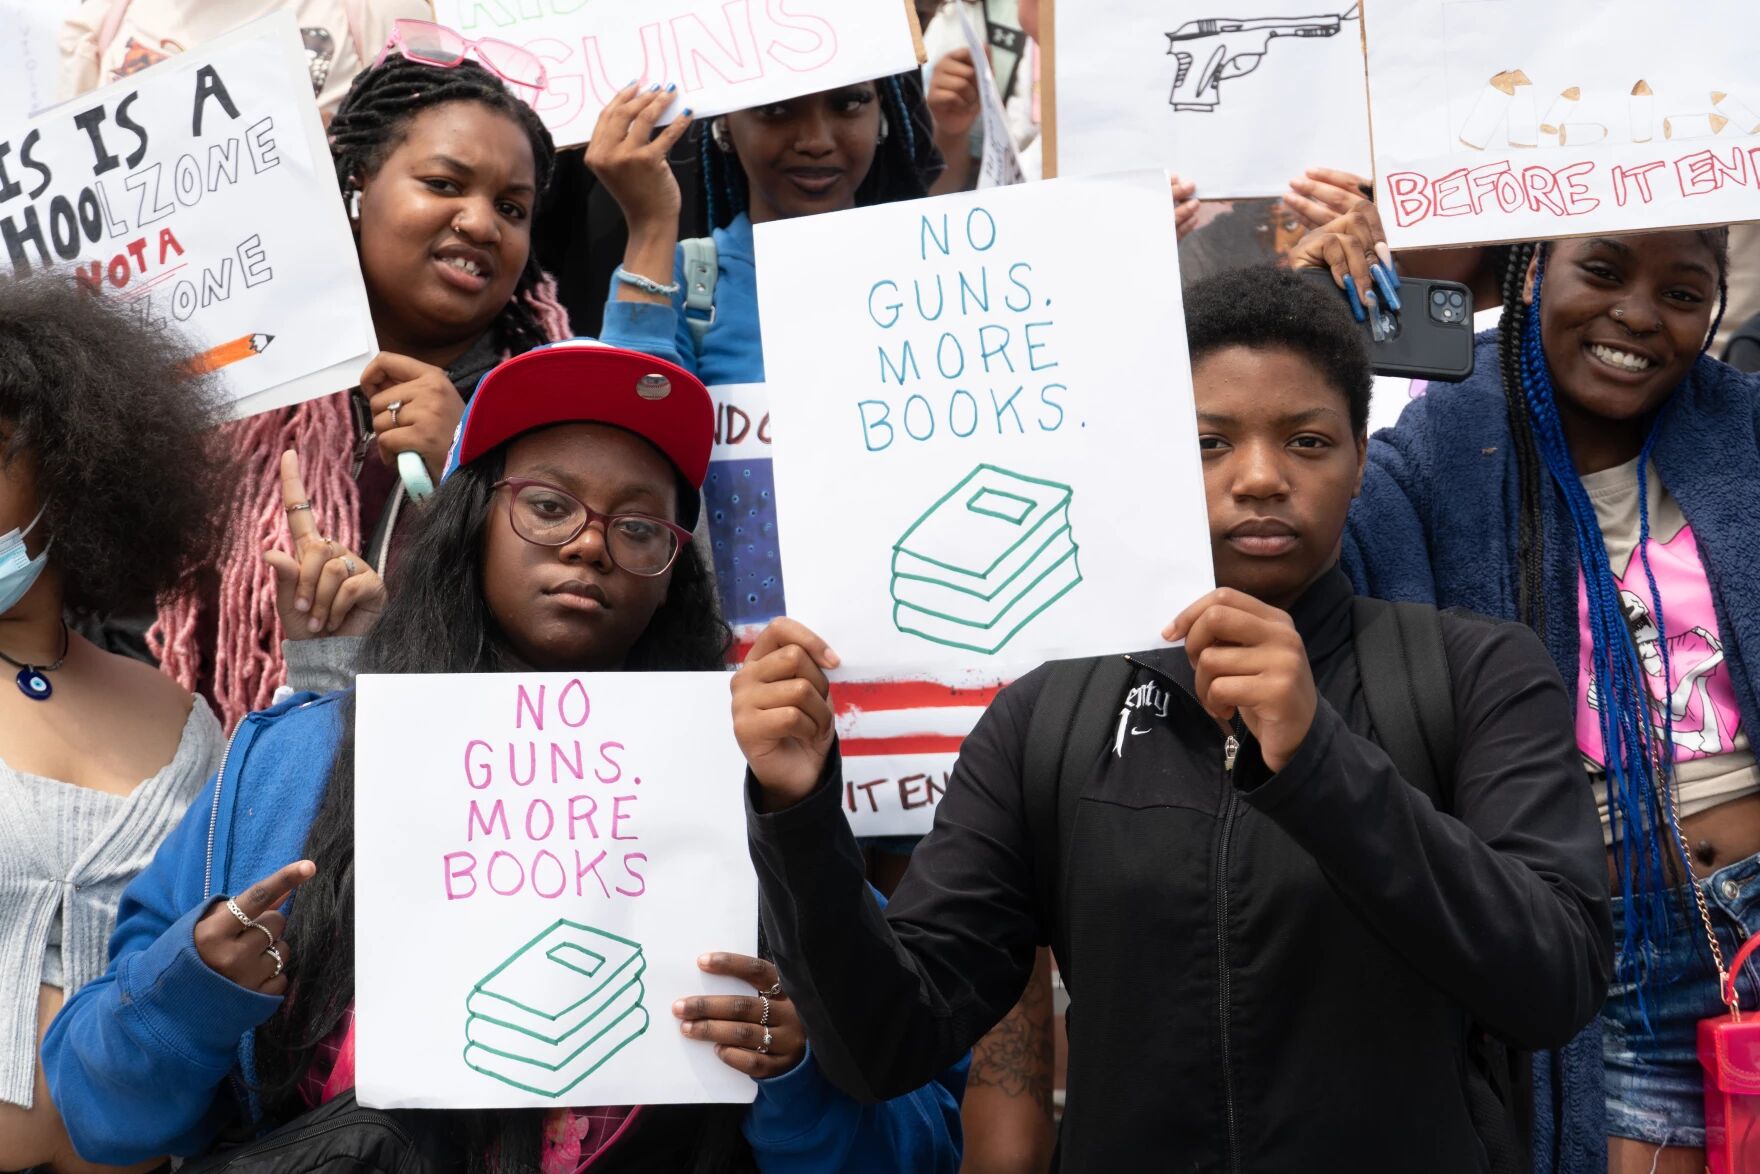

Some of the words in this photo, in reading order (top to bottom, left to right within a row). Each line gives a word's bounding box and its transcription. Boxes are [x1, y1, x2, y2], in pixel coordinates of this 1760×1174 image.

[512, 0, 838, 130] GUNS
[73, 90, 149, 176] IS
[192, 64, 240, 137] A
[1387, 160, 1601, 227] BEFORE
[1611, 161, 1665, 206] IT
[75, 236, 148, 298] NOT
[158, 227, 185, 265] A
[920, 207, 997, 261] NO
[868, 262, 1053, 329] GUNS.
[878, 320, 1060, 386] MORE
[857, 383, 1087, 452] BOOKS.
[515, 678, 590, 731] NO
[464, 739, 642, 790] GUNS.
[847, 778, 888, 812] IT
[467, 794, 639, 842] MORE
[443, 849, 648, 900] BOOKS
